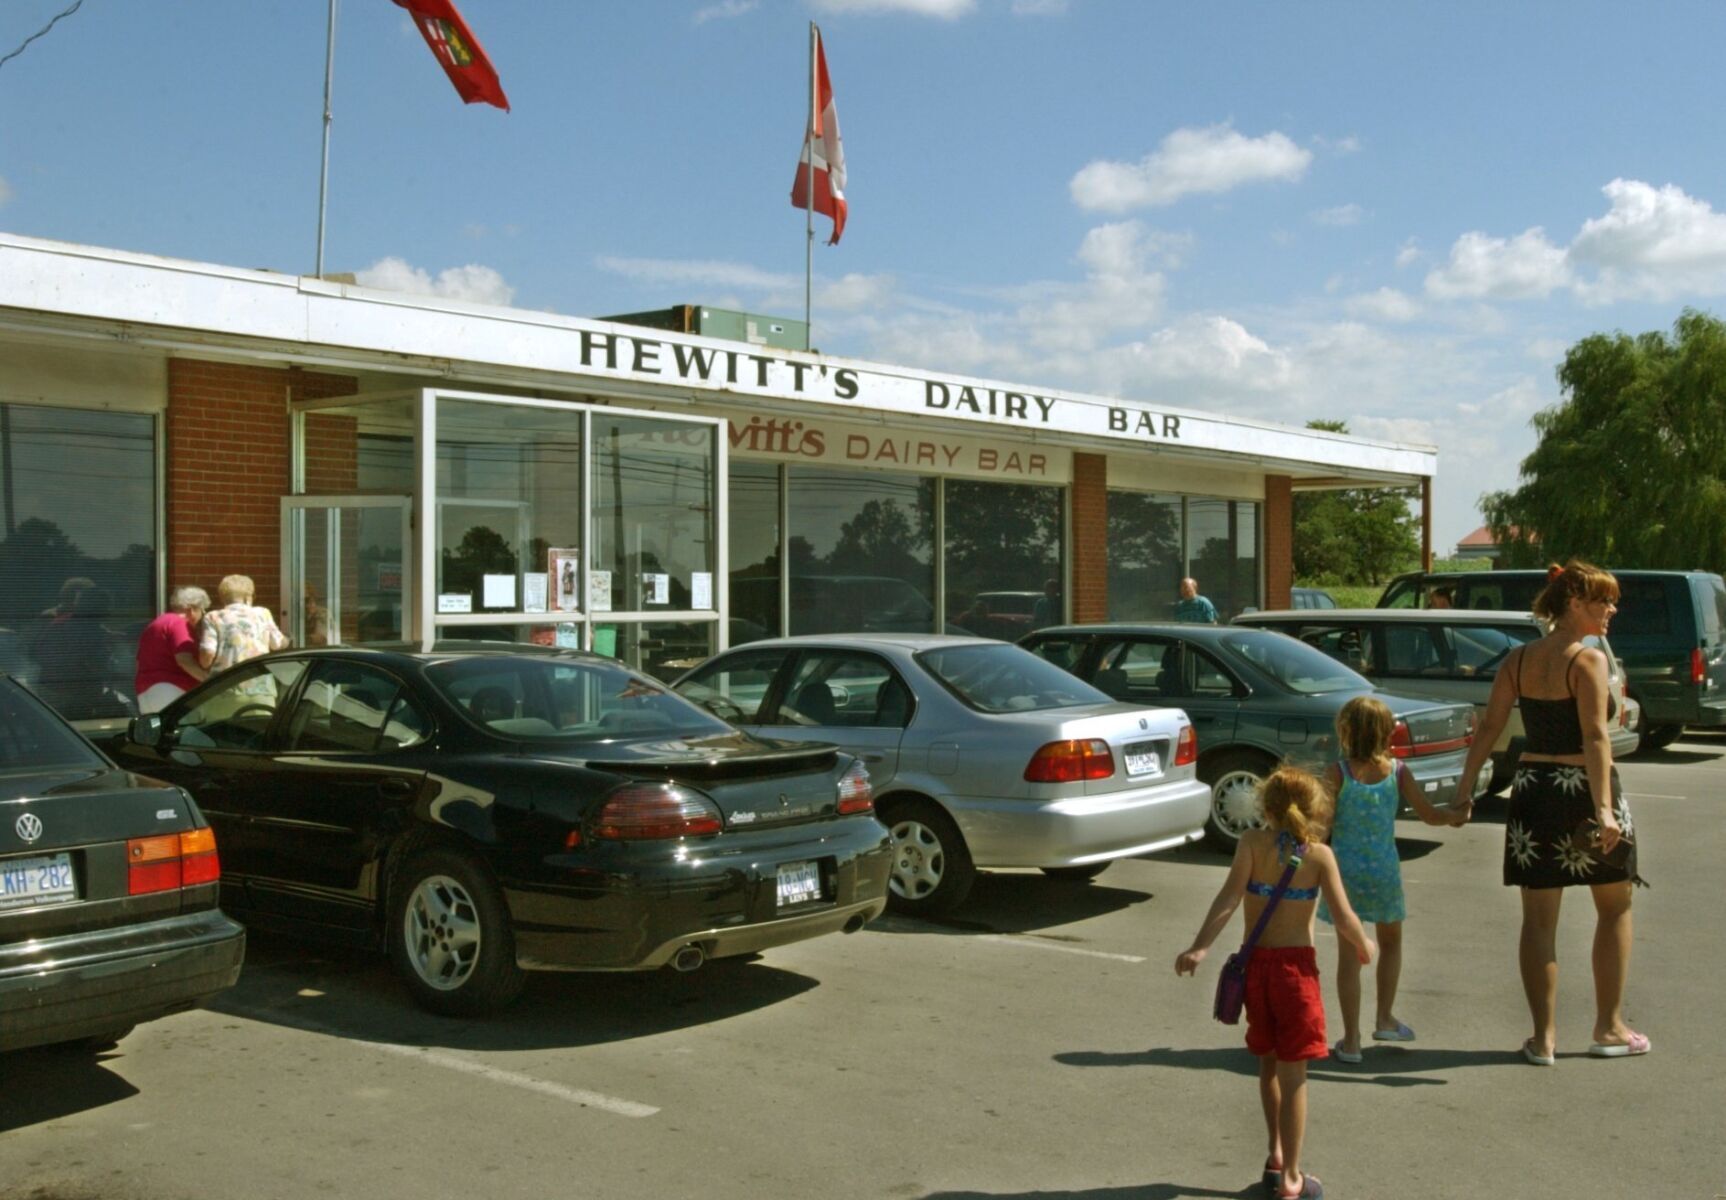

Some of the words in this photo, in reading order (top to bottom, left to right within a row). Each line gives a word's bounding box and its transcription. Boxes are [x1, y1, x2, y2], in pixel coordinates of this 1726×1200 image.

[580, 330, 859, 400] HEWITT'S
[925, 380, 1057, 423] DAIRY
[1108, 407, 1182, 439] BAR
[846, 434, 962, 468] DAIRY
[977, 448, 1047, 476] BAR
[0, 867, 28, 895] KH
